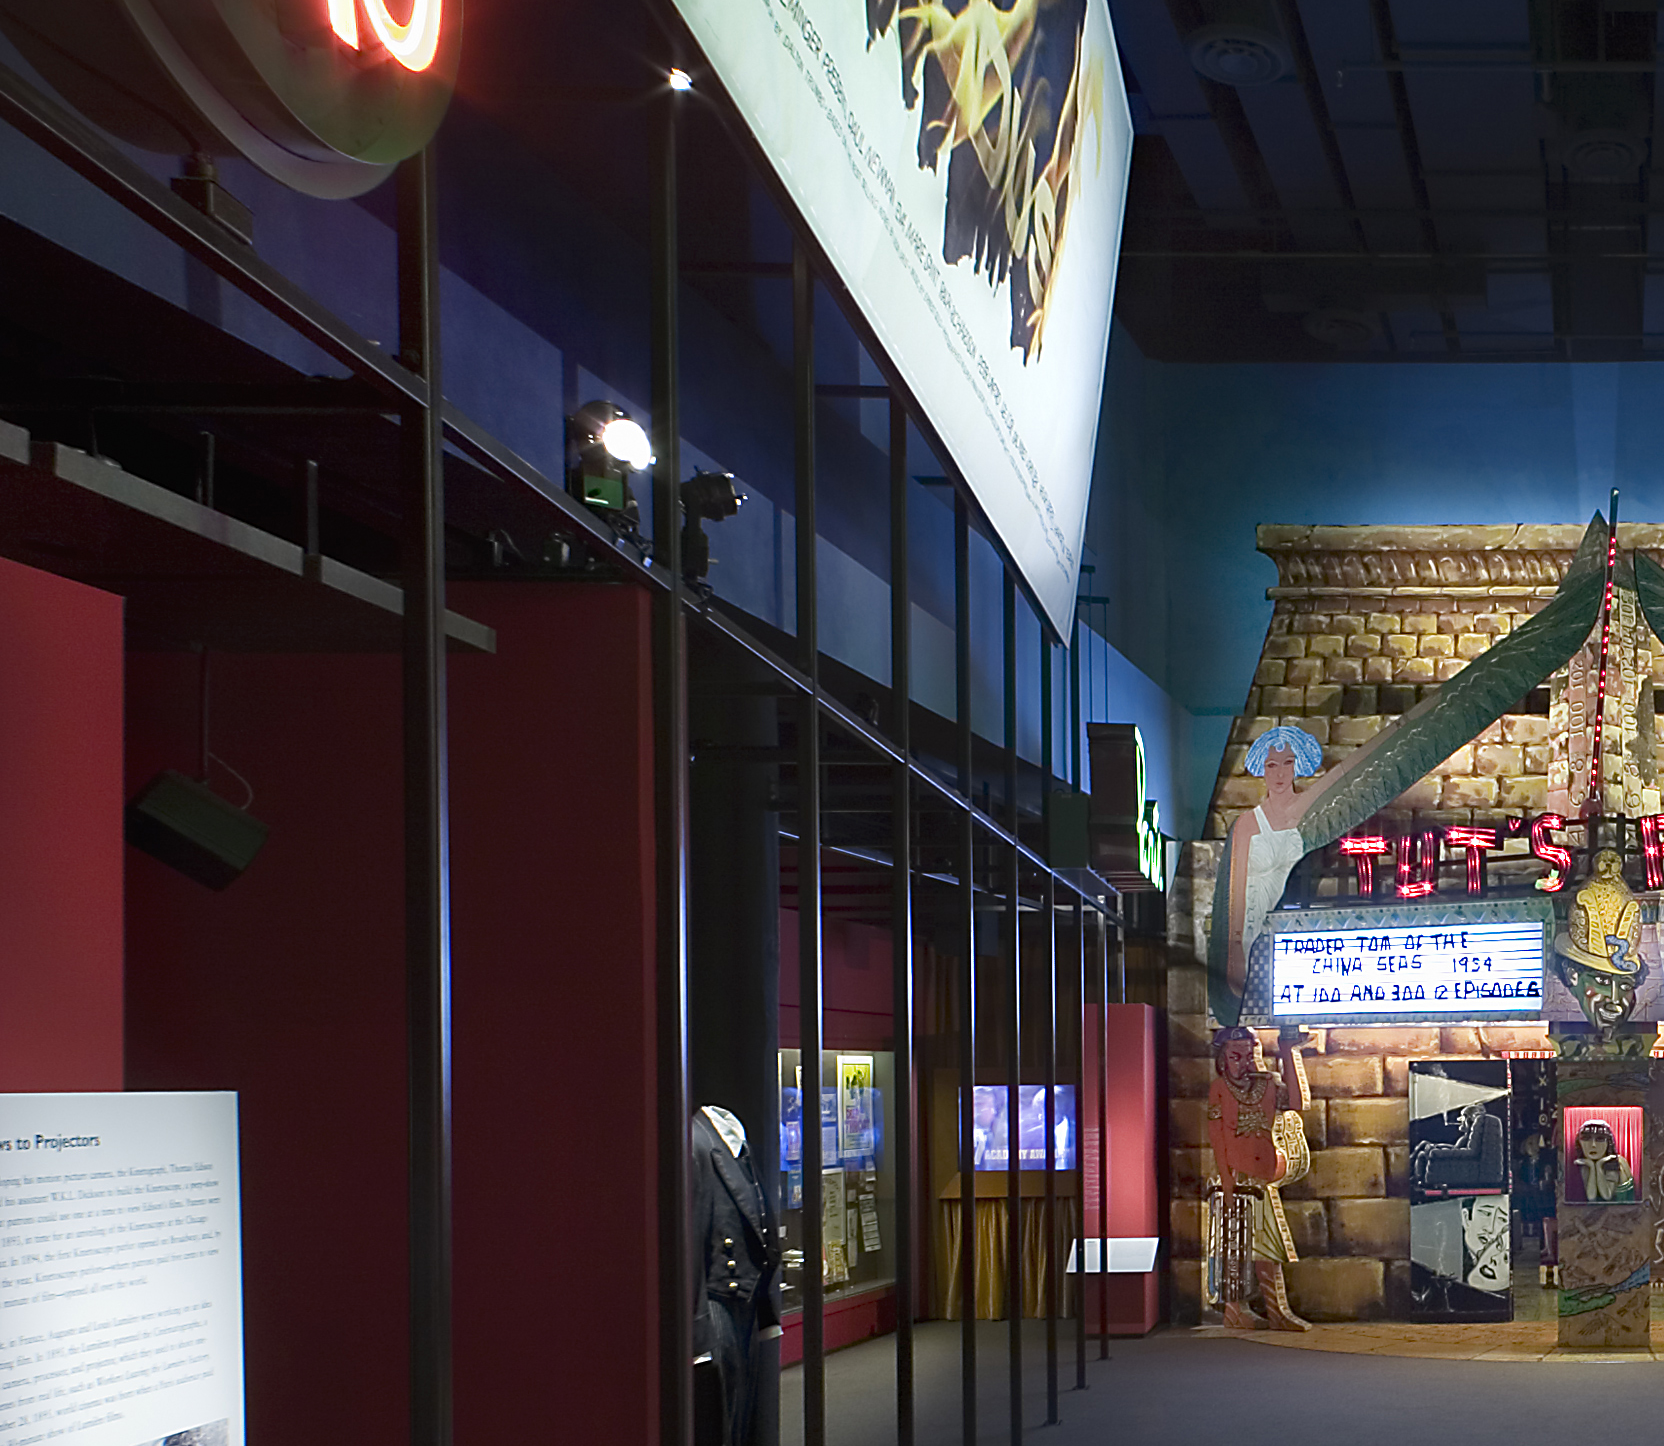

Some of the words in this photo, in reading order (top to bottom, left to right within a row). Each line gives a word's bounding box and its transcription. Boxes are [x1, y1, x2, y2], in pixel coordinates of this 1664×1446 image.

[1622, 658, 1637, 685] 102
[1570, 702, 1585, 737] 100
[1622, 703, 1637, 733] 100
[1624, 792, 1640, 808] 6
[1340, 811, 1572, 898] TUT'S
[1282, 938, 1344, 955] TRADER
[1357, 936, 1391, 952] TOM
[1405, 934, 1423, 951] OF
[1430, 932, 1469, 949] THE
[1312, 957, 1363, 976] CHINA
[1377, 955, 1423, 972] SEAS
[1452, 957, 1493, 973] 1954
[1280, 985, 1304, 1003] AT
[1314, 985, 1341, 1003] 100
[1351, 984, 1385, 1001] AND
[1392, 984, 1425, 1001] 300
[1454, 980, 1540, 998] EPISODES
[16, 1139, 30, 1150] to
[35, 1134, 101, 1152] Projectors
[985, 1149, 1027, 1160] ACADY
